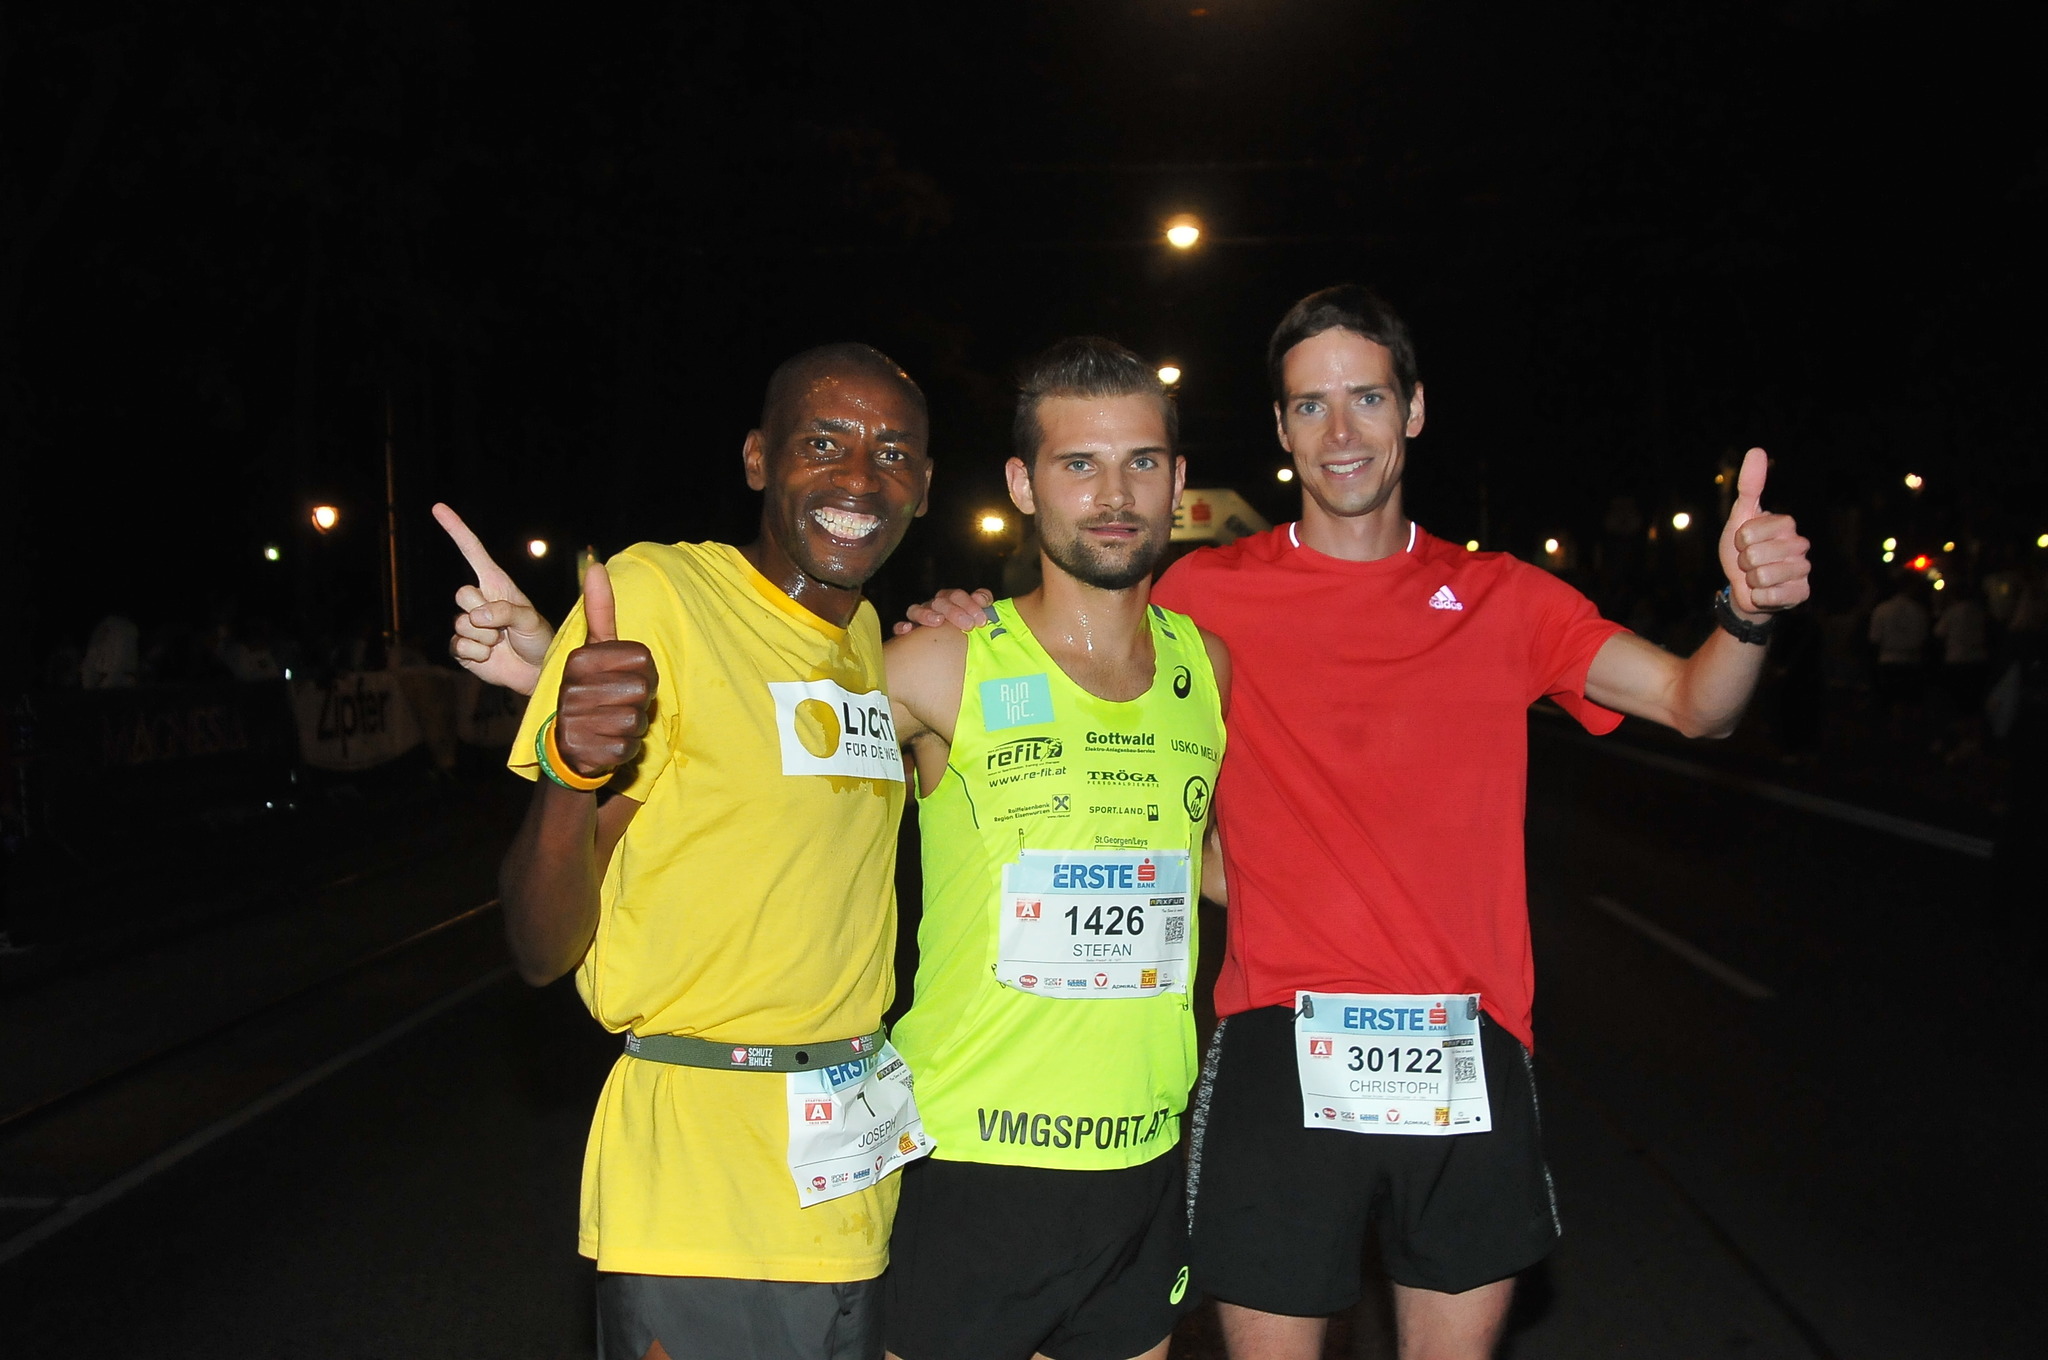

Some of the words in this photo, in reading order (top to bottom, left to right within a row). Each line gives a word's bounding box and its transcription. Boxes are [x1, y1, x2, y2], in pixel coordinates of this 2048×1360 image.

[1086, 731, 1155, 746] Gottwald
[1170, 739, 1199, 755] USKO
[845, 742, 868, 758] FÜR
[871, 745, 884, 759] DE
[988, 743, 1041, 770] refit
[989, 766, 1067, 788] www.re-fit.at
[1087, 769, 1159, 783] TRÖGA
[1053, 864, 1133, 889] ERSTE
[1064, 905, 1144, 936] 1426
[1072, 943, 1132, 957] STEFAN
[1343, 1006, 1424, 1031] ERSTE
[748, 1047, 773, 1057] SCHUTZ
[1347, 1046, 1443, 1074] 30122
[1349, 1079, 1440, 1095] CHRISTOPH
[858, 1116, 897, 1149] JOSEPH
[977, 1106, 1170, 1149] VMGSPORT.AT
